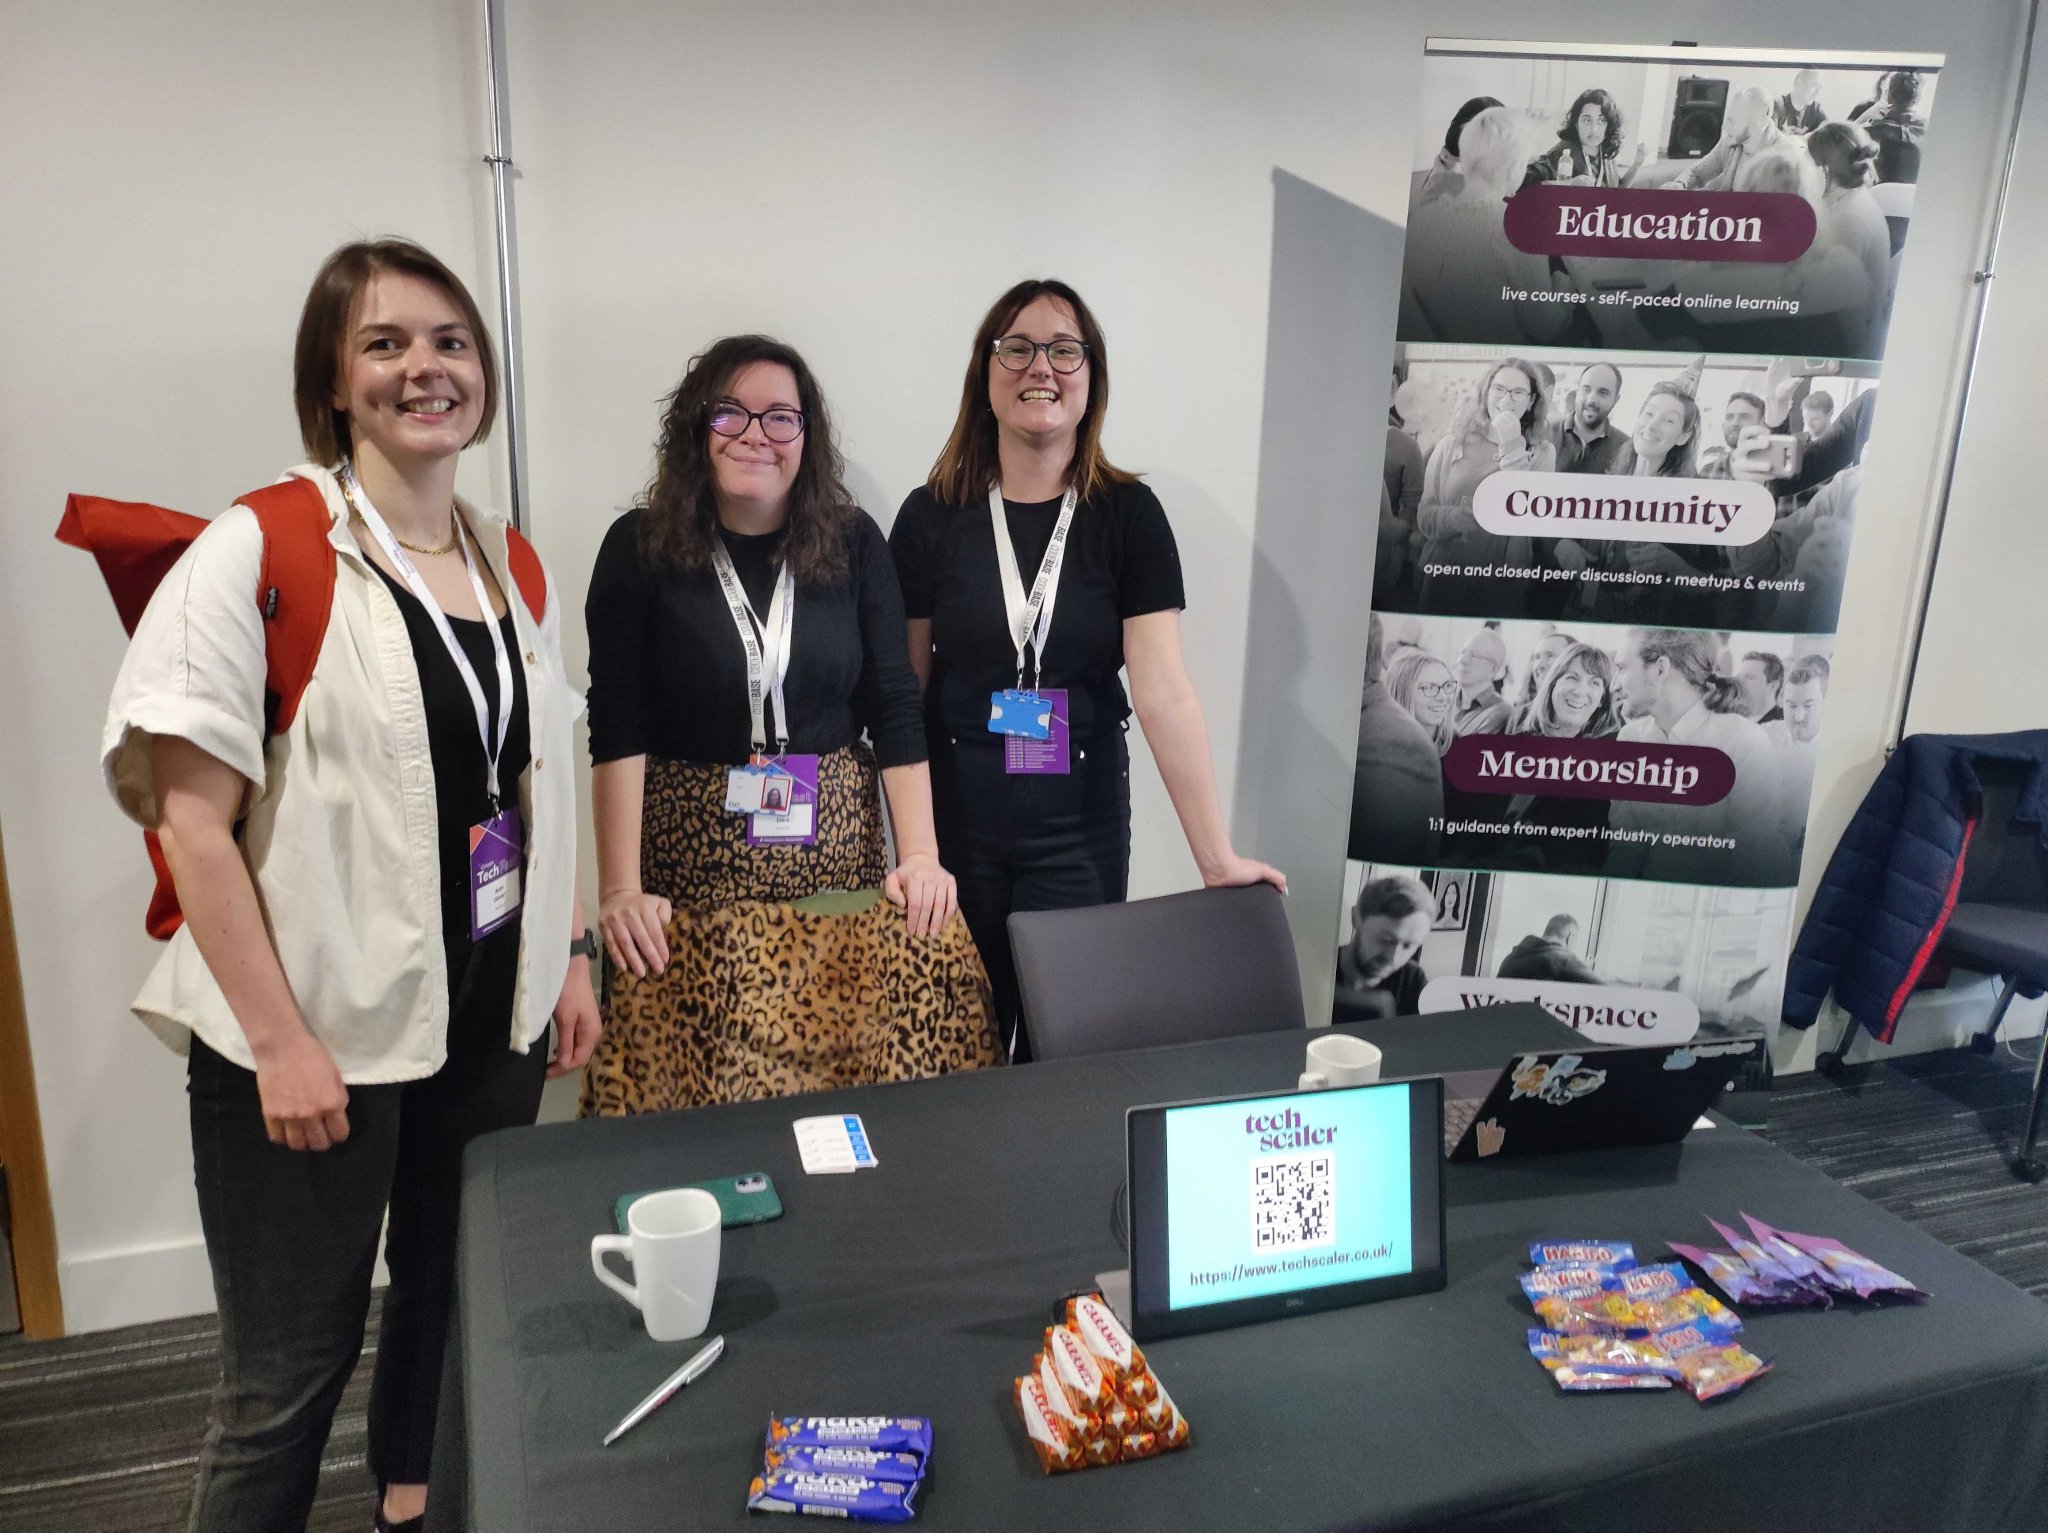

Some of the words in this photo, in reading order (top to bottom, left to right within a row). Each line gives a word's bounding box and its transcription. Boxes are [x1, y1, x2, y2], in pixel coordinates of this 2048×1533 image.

[1556, 205, 1763, 243] Education
[1501, 286, 1528, 301] live
[1530, 289, 1587, 304] courses
[1598, 290, 1682, 309] self-paced
[1684, 293, 1733, 308] online
[1735, 295, 1800, 314] learning
[1504, 489, 1742, 533] Community
[1423, 563, 1461, 577] open
[1464, 563, 1493, 577] and
[1494, 564, 1541, 579] closed
[1543, 568, 1577, 582] peer
[1579, 568, 1663, 585] discussions
[1674, 573, 1741, 591] meetups
[1743, 576, 1755, 590] &
[1757, 578, 1806, 592] events
[1477, 749, 1699, 795] Mentorship
[1428, 817, 1444, 831] 1:1
[1446, 819, 1511, 835] guidance
[1513, 821, 1548, 836] from
[1550, 826, 1598, 840] expert
[1600, 827, 1660, 846] industry
[1662, 833, 1736, 850] operators
[1460, 993, 1658, 1030] Wspace
[1245, 1106, 1302, 1135] tech
[1260, 1123, 1338, 1152] scaler
[1189, 1241, 1394, 1287] https://www.techscaler.co.uk/
